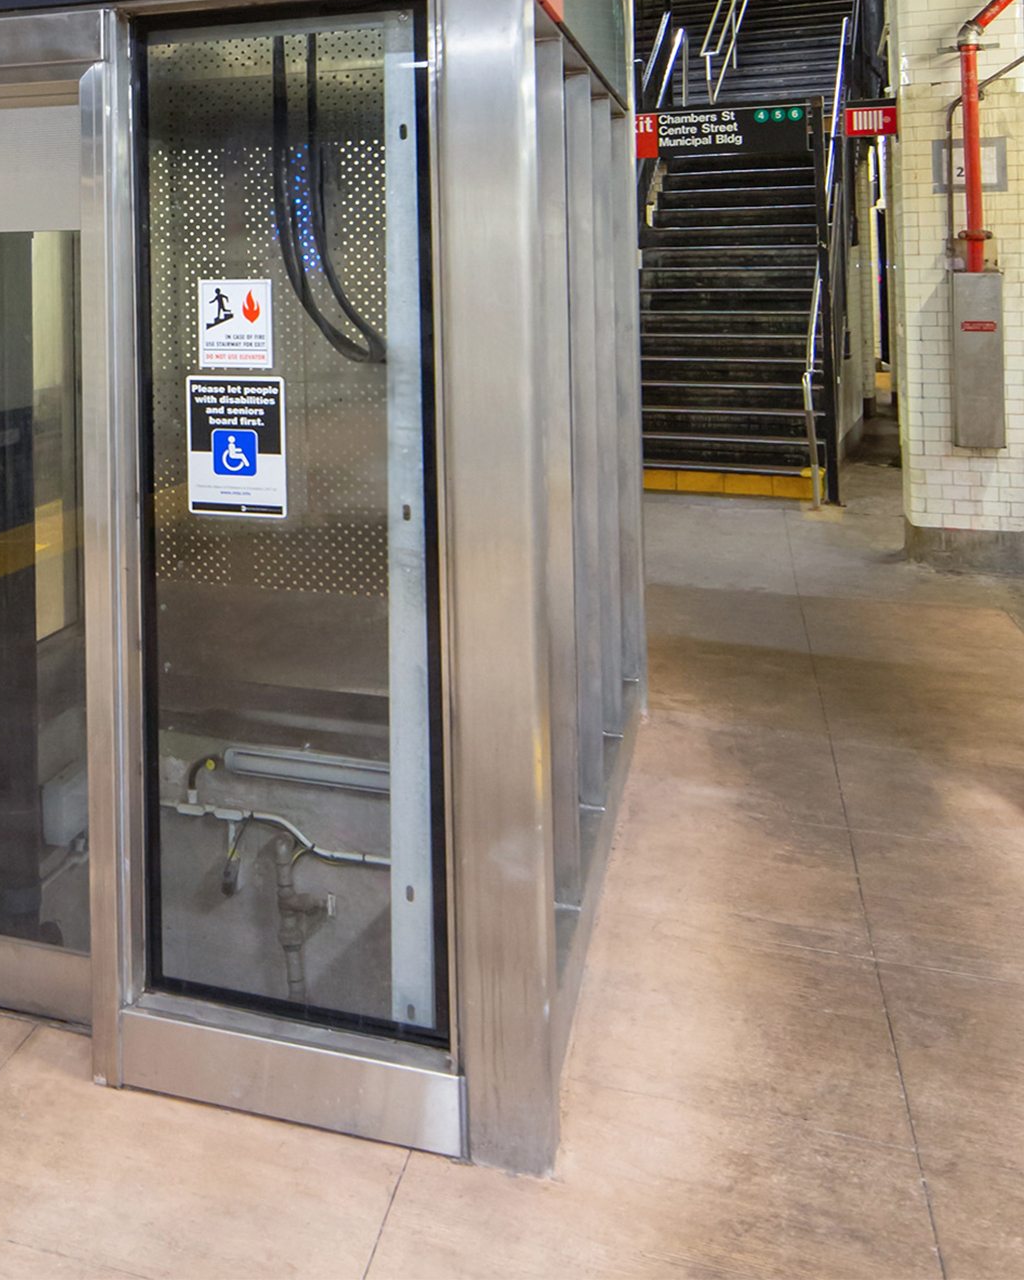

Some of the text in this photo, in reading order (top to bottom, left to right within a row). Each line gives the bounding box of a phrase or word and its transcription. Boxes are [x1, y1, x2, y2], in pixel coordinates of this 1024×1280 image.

[658, 111, 735, 125] Chambers St
[635, 117, 653, 133] it
[659, 122, 738, 136] Centre Street
[659, 134, 743, 147] Municipal Bldg
[191, 384, 279, 396] Please let people
[195, 395, 276, 405] with disabilities
[205, 406, 265, 416] and seniors
[209, 417, 265, 426] board first.
